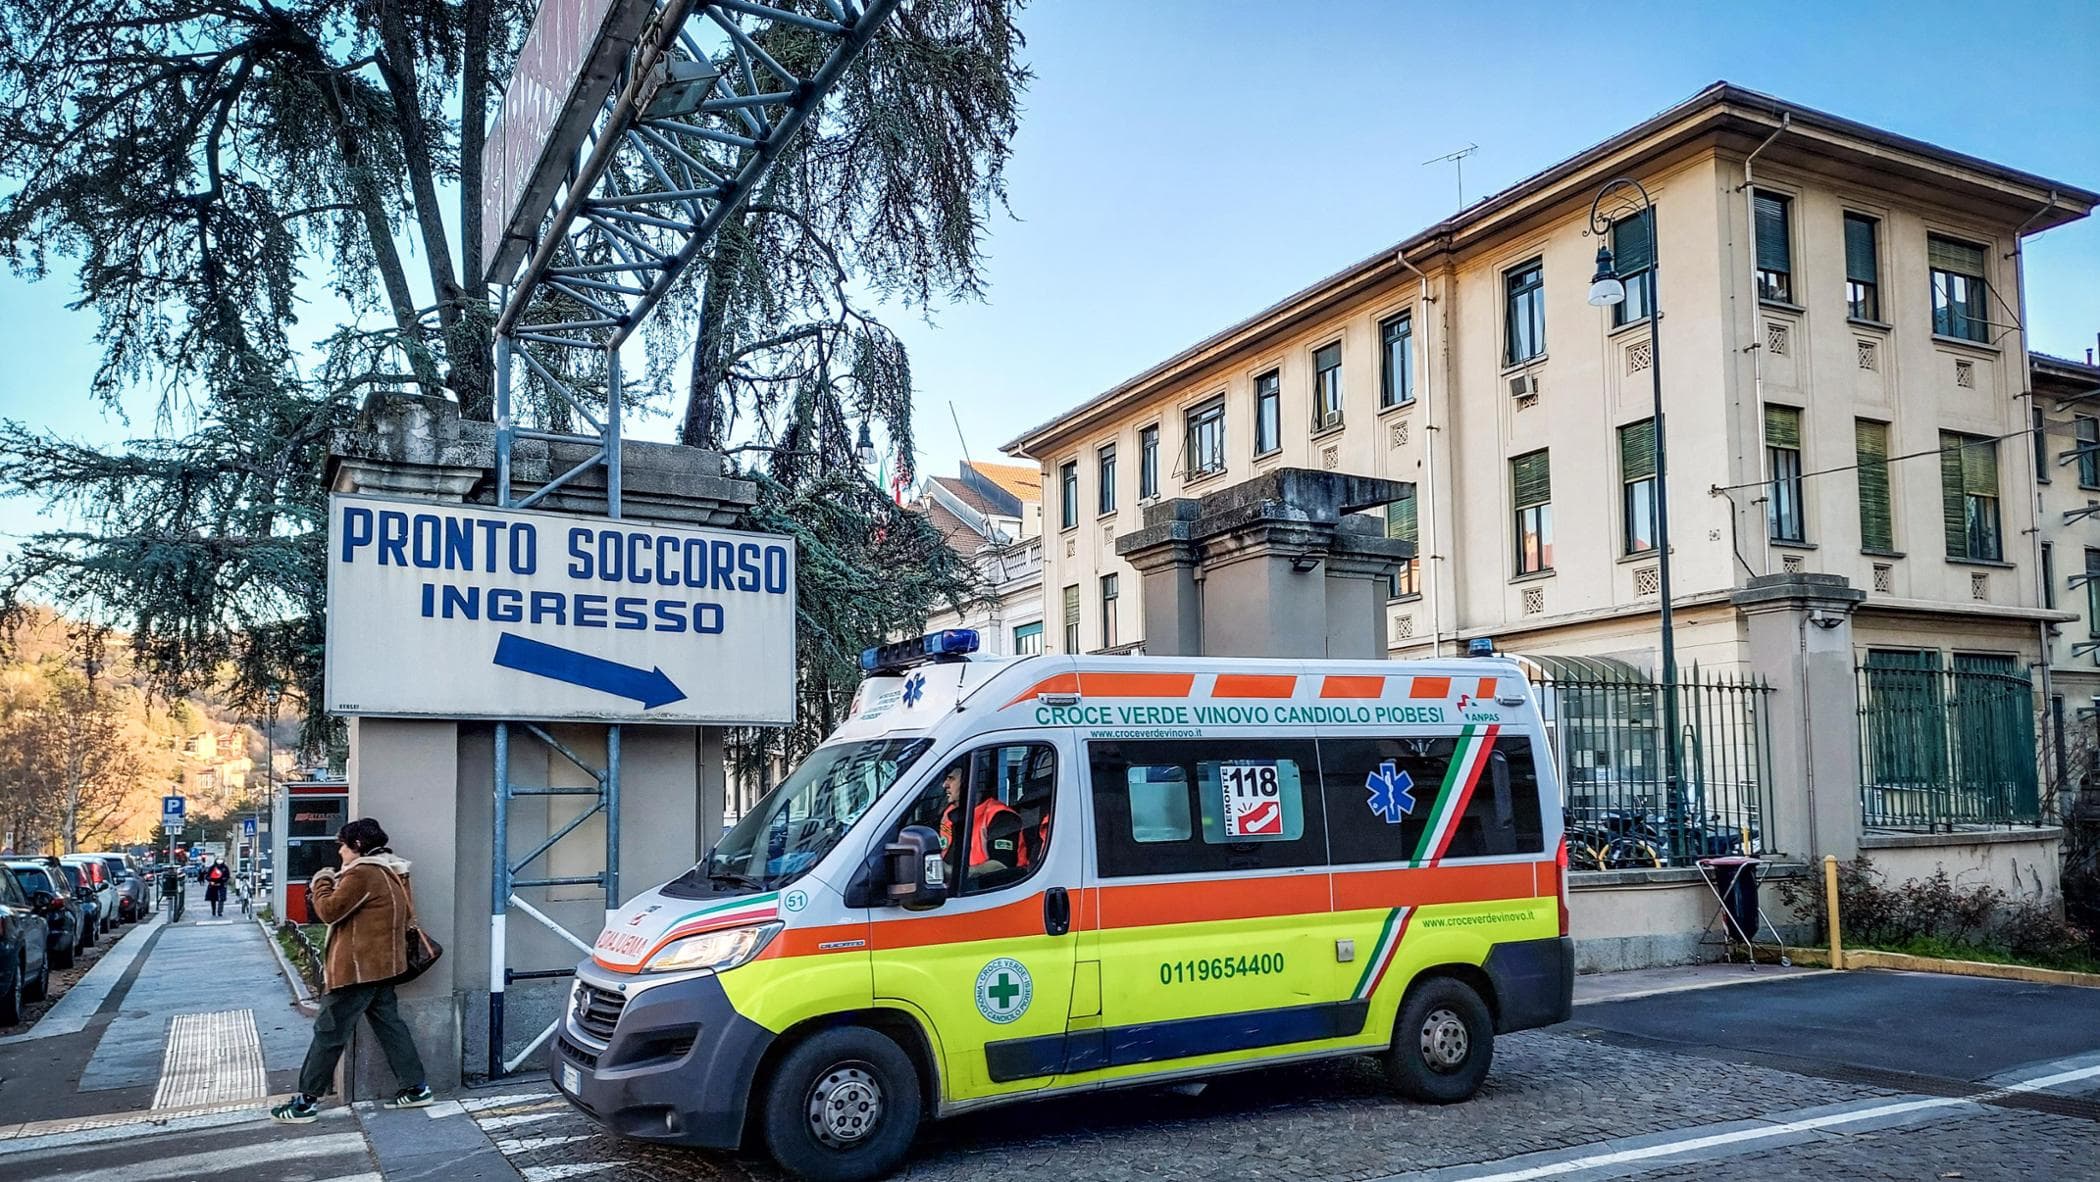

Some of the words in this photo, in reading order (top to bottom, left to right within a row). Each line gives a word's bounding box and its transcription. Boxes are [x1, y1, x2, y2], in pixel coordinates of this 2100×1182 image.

[342, 506, 537, 576] PRONTO
[568, 527, 787, 595] SOCCORSO
[421, 583, 725, 635] INGRESSO
[1035, 706, 1113, 725] CROCE
[1118, 706, 1189, 725] VERDE
[1193, 706, 1269, 724] VINOVO
[1274, 706, 1371, 724] CANDIOLO
[1376, 706, 1445, 723] PIOBESI
[1471, 713, 1500, 722] ANPAS
[1090, 728, 1202, 738] www.croceverdevinovo.it
[1229, 767, 1278, 797] 118
[167, 799, 180, 813] P
[1221, 768, 1234, 835] PIEMONTE
[788, 895, 803, 907] 51
[1422, 910, 1535, 928] www.croceverdevinovo.it
[980, 961, 1003, 981] CROCE
[1004, 961, 1027, 978] VERDE
[1160, 952, 1284, 985] 0119654400
